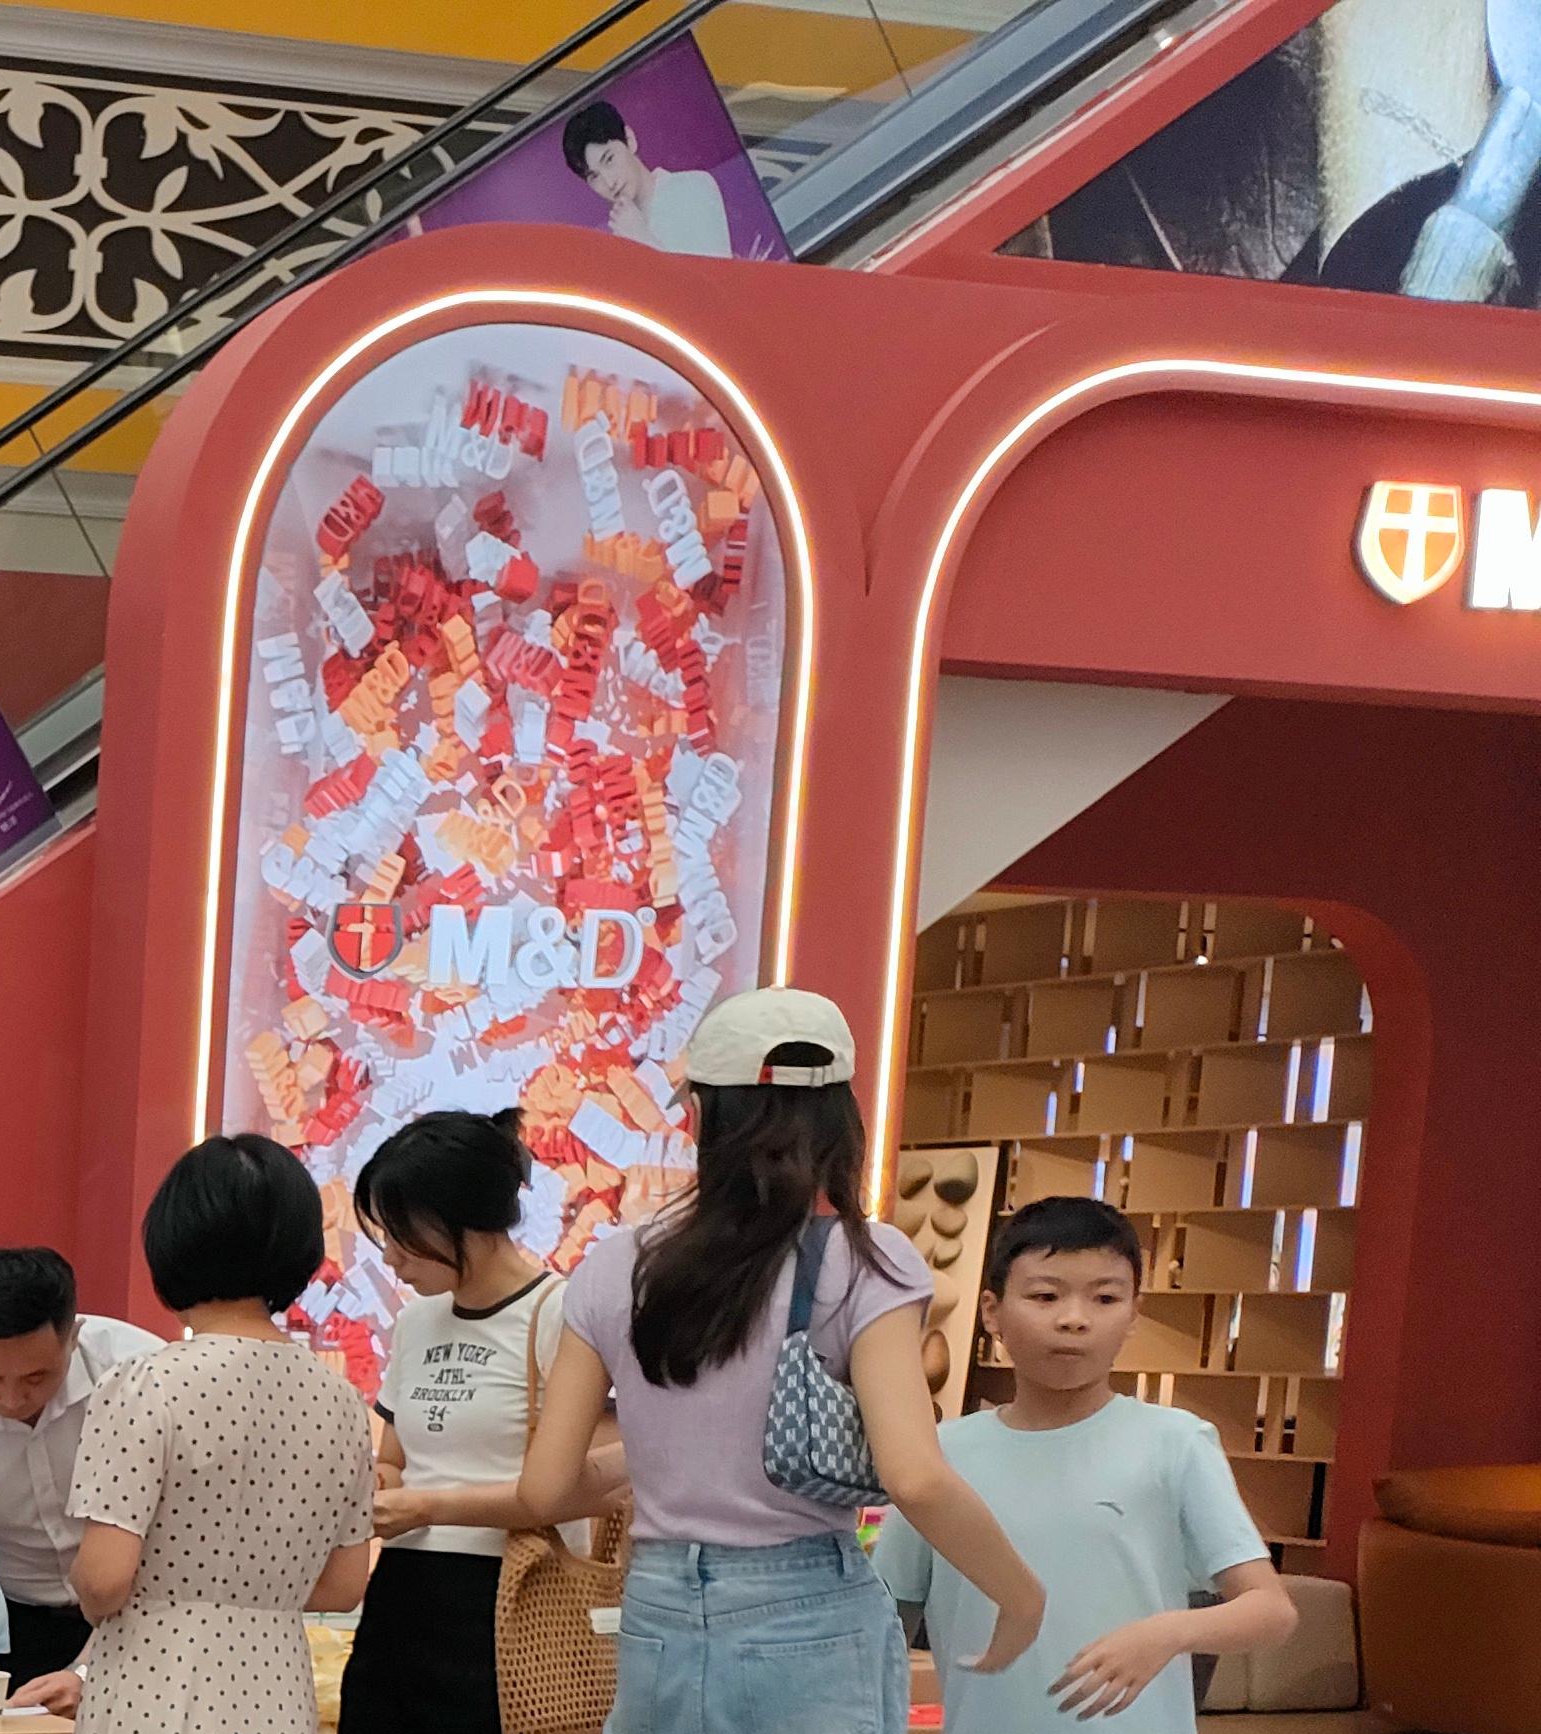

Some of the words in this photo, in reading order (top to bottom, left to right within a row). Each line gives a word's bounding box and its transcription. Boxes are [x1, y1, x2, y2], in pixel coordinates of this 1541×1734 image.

[423, 1343, 453, 1365] NEW
[458, 1343, 497, 1366] YORK
[410, 1388, 476, 1402] BROOKLYN
